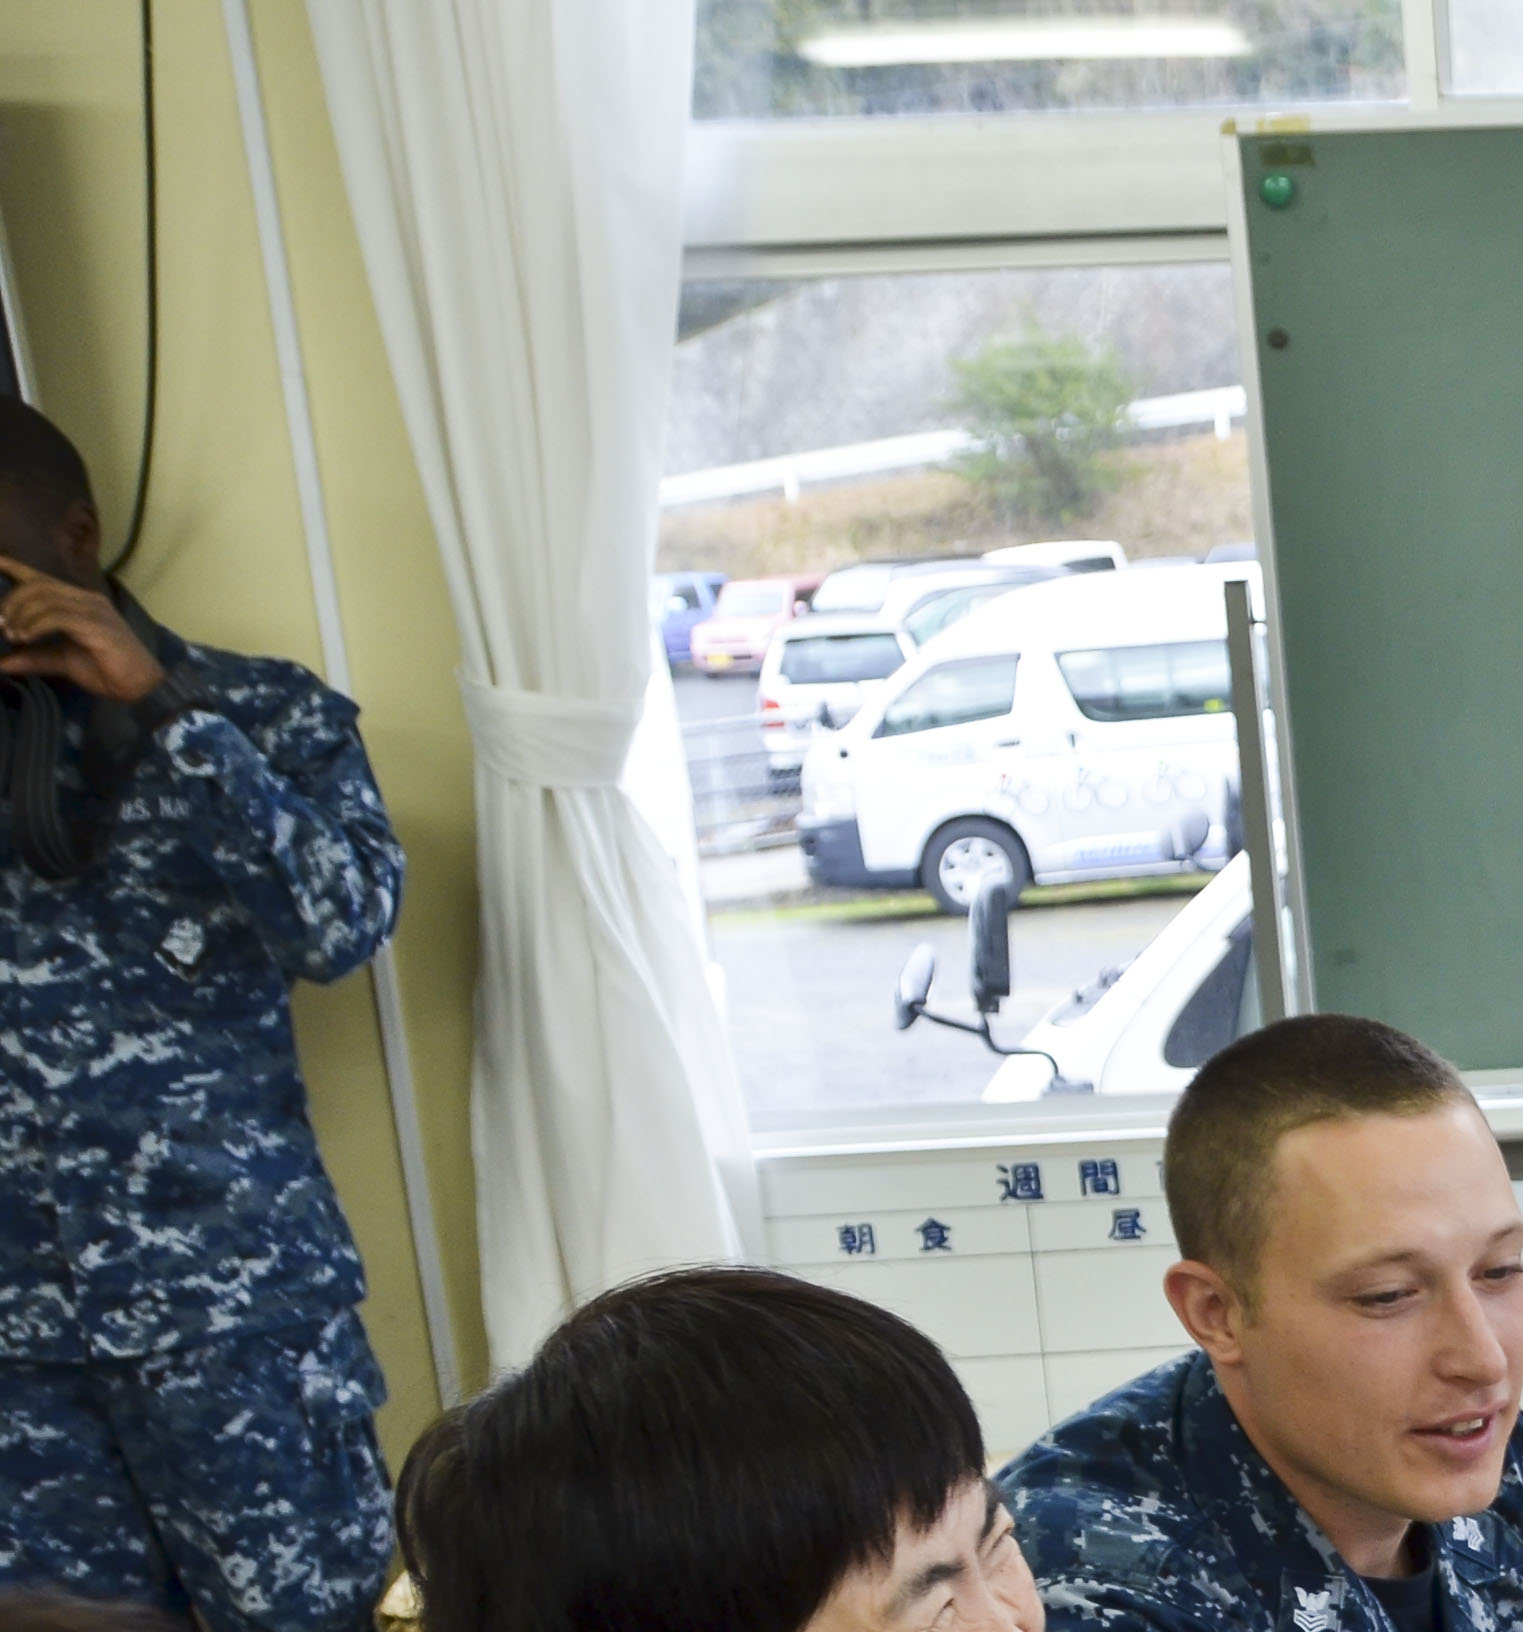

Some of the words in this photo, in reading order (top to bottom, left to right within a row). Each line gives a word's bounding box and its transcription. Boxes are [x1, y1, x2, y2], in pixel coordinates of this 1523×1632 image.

[996, 1158, 1168, 1203] 週間
[837, 1216, 953, 1256] 朝食
[1108, 1208, 1147, 1241] 昼
